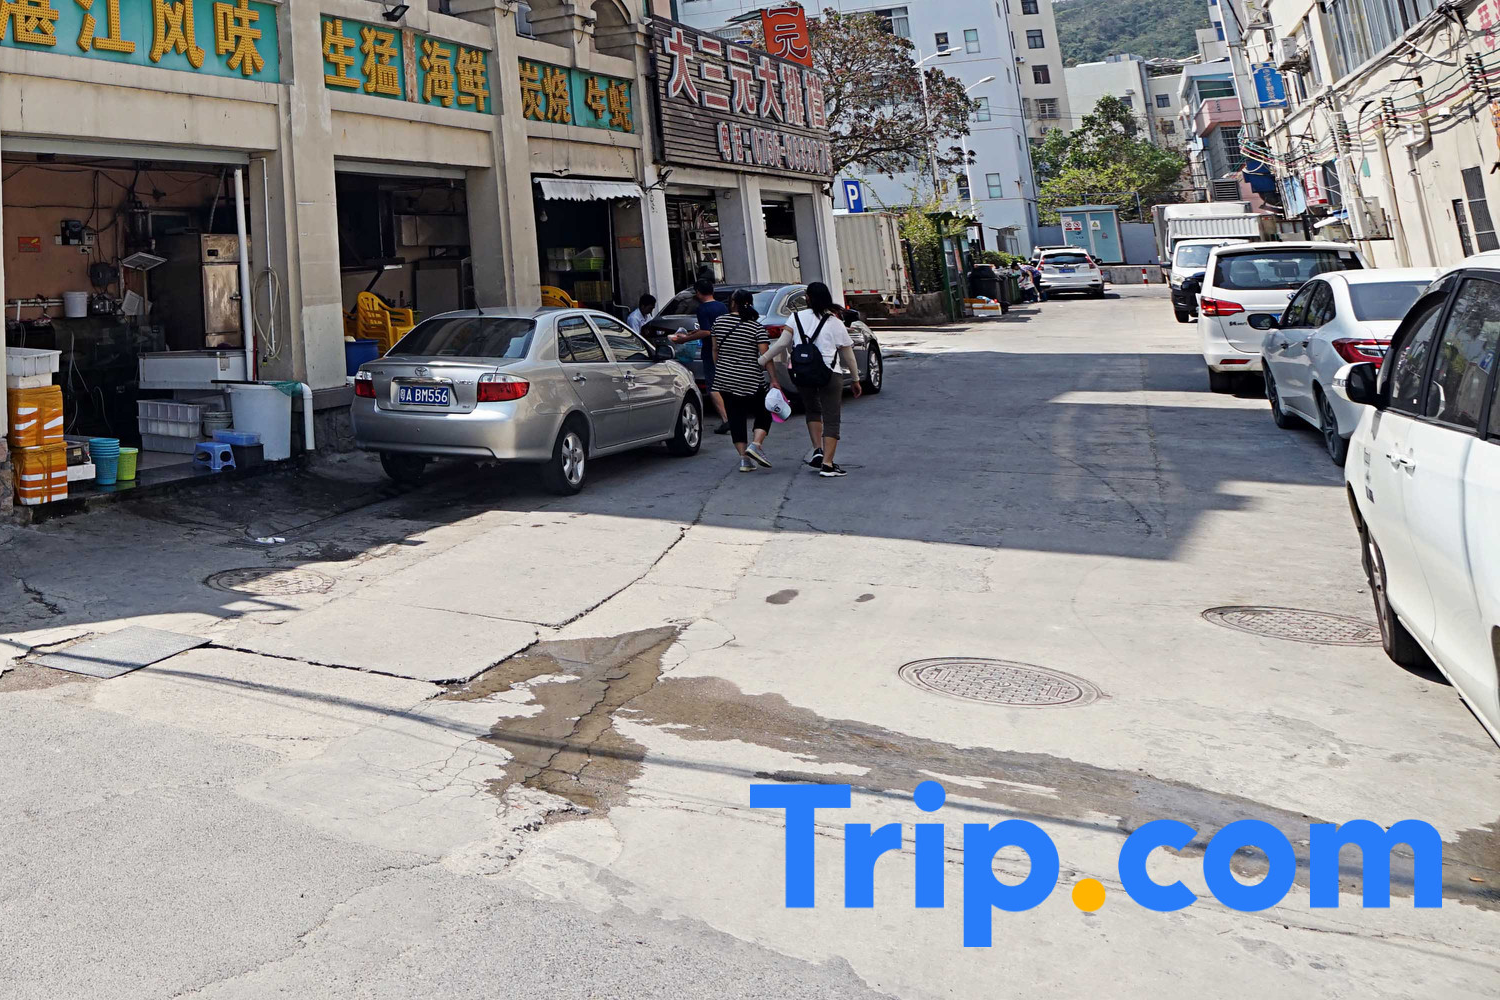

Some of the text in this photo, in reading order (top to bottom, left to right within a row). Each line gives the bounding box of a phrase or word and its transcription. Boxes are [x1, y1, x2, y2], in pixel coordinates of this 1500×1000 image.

[322, 18, 489, 112] 生猛海鲜
[664, 26, 826, 129] 大三元大排档
[846, 184, 859, 210] P
